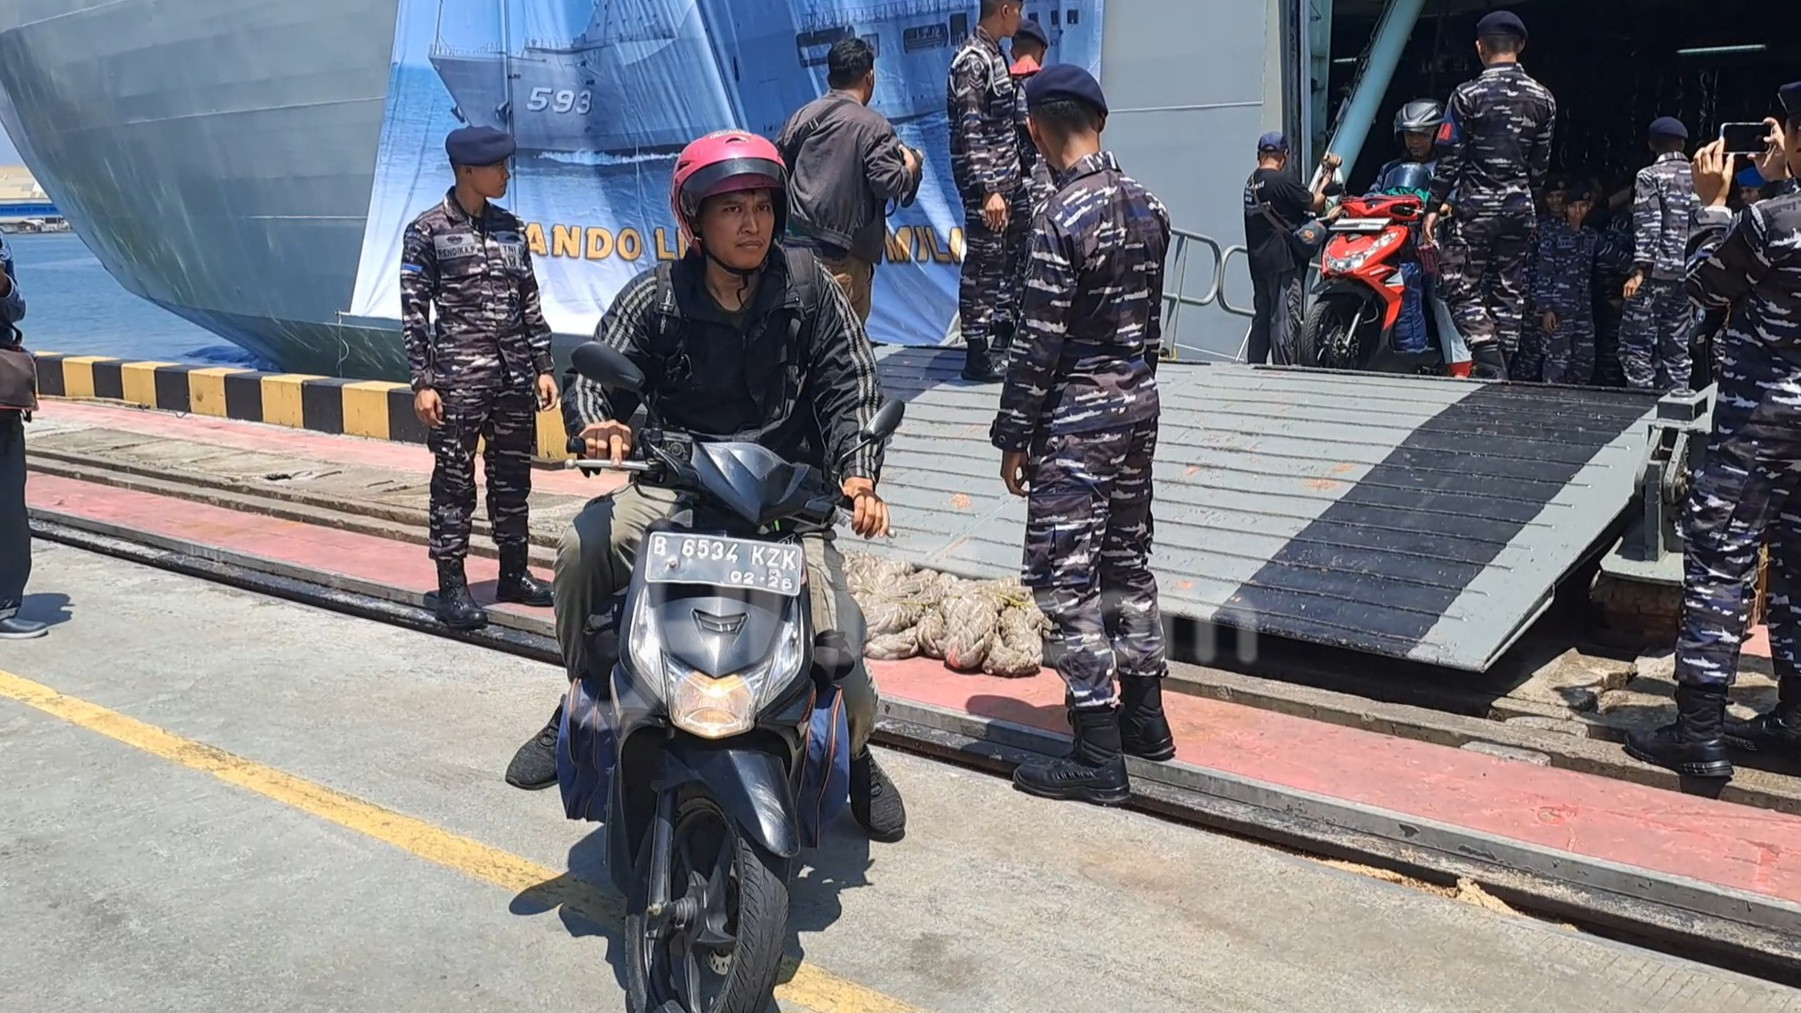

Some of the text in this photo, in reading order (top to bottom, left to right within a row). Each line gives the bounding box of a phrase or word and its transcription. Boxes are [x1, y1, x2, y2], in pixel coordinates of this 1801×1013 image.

[526, 86, 592, 115] 593
[525, 222, 642, 261] ANDO
[653, 536, 797, 571] B 6534 KZK
